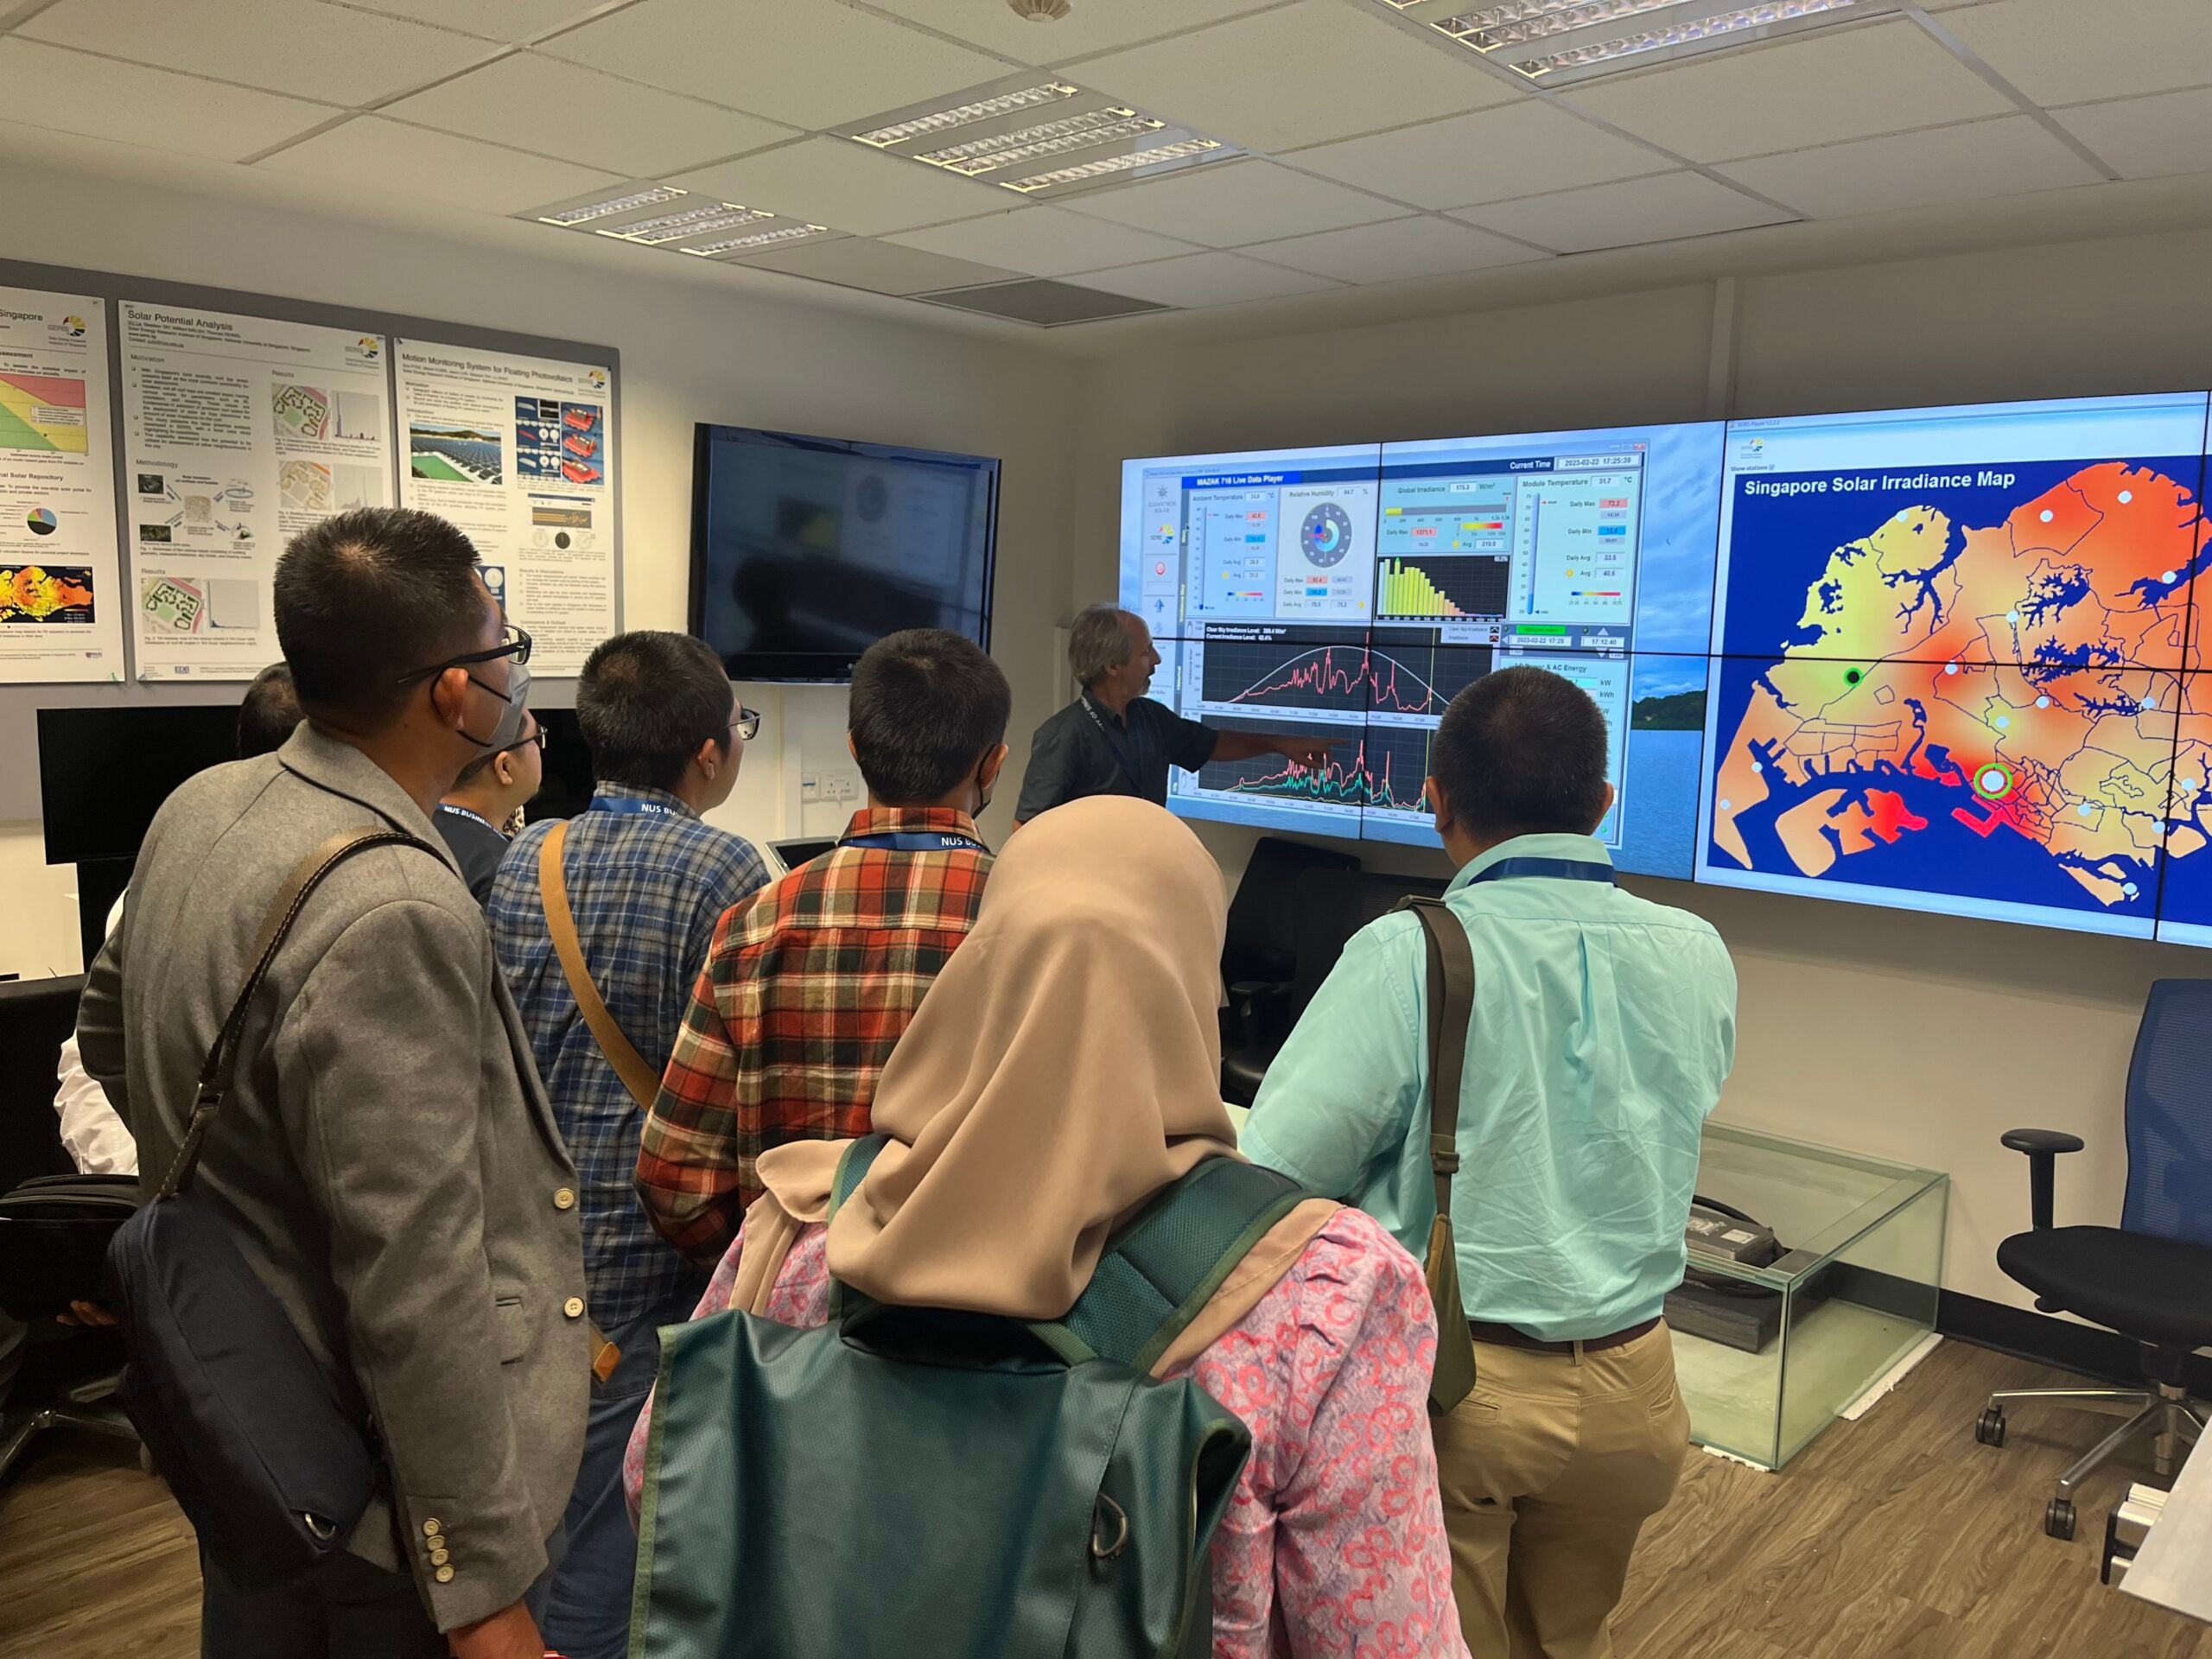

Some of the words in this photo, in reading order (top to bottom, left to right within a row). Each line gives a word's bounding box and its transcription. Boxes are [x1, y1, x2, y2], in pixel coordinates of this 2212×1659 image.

[128, 310, 152, 321] Solar
[155, 313, 194, 326] Potential
[196, 319, 233, 330] Analysis
[130, 353, 165, 363] Motivation
[402, 353, 427, 363] Motion
[429, 356, 465, 370] Monitoring
[467, 361, 492, 372] System
[504, 367, 530, 378] Floating
[1510, 461, 1535, 469] Current
[1535, 460, 1552, 468] Time
[1565, 458, 1599, 467] 2023-02-22
[29, 473, 64, 481] Repository
[1233, 474, 1246, 484] Live
[1248, 474, 1262, 484] Data
[1263, 474, 1284, 484] Player
[1548, 479, 1588, 487] Temperature
[1744, 480, 1828, 497] Singapore
[1832, 476, 1878, 493] Solar
[1881, 473, 1973, 491] Irradiance
[1976, 471, 2017, 490] Map
[1563, 664, 1586, 673] Energy
[641, 804, 662, 813] NUS
[941, 836, 963, 847] NUS
